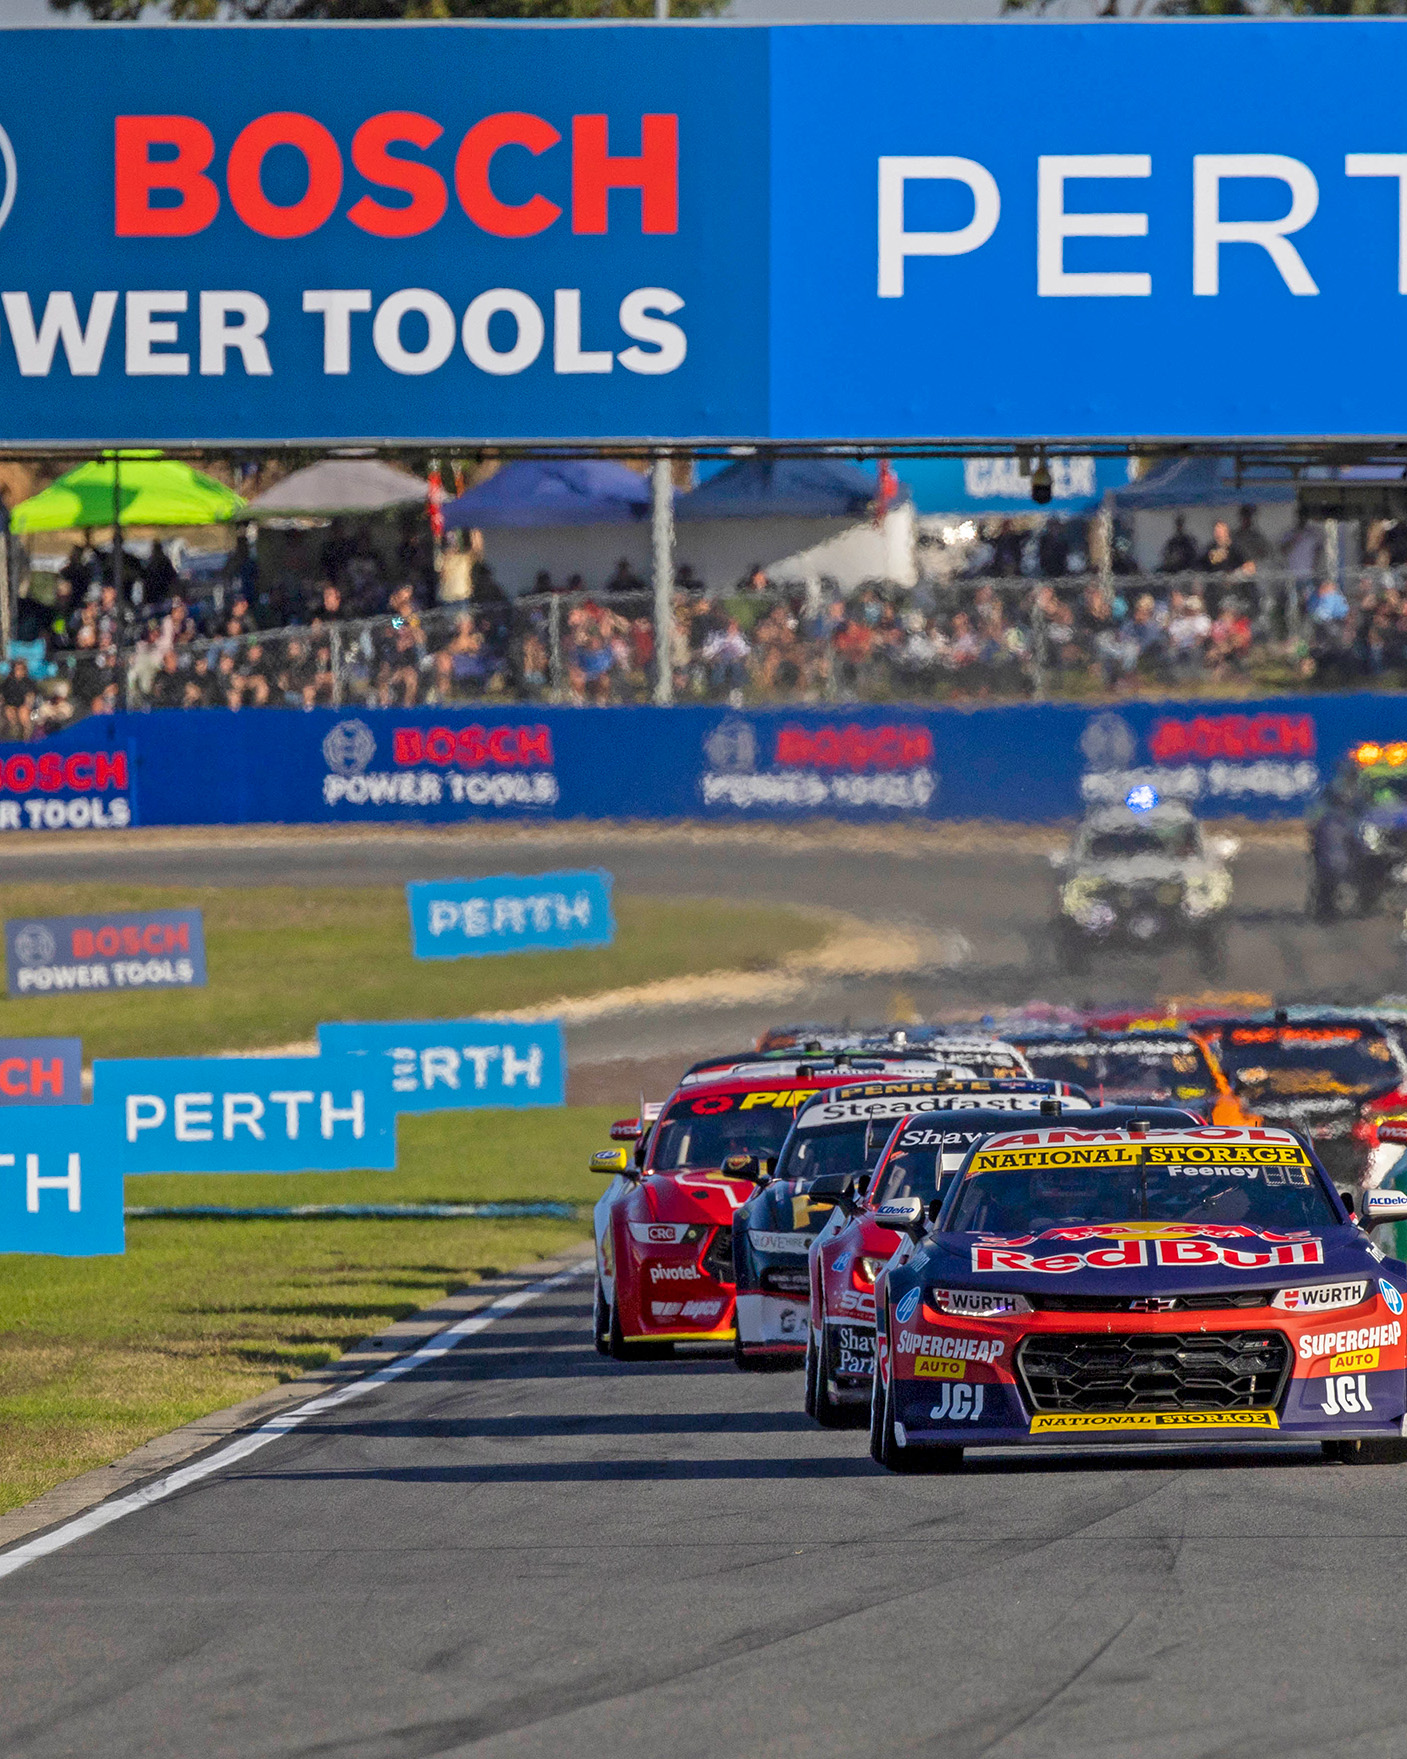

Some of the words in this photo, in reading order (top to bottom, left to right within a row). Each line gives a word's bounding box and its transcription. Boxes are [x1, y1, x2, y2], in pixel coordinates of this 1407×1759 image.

[115, 110, 680, 239] BOSCH
[0, 289, 273, 377] WER
[302, 287, 688, 376] TOOLS
[394, 725, 553, 768] BOSCH
[0, 751, 128, 793] OSCH
[323, 771, 442, 806] POWER
[23, 797, 131, 829] TOOLS
[428, 891, 590, 937] PERTH
[72, 922, 189, 959] BOSCH
[17, 964, 109, 991] POWER
[111, 959, 194, 986] TOOLS
[389, 1044, 543, 1092] ERTH
[125, 1090, 365, 1143] PERTH
[823, 1097, 1022, 1119] Steadfast
[985, 1128, 1291, 1149] AMPOL
[978, 1148, 1134, 1169] NATIONAL
[1150, 1147, 1298, 1163] STORAGE
[1168, 1166, 1259, 1179] Feeney
[649, 1227, 675, 1239] CRC
[972, 1240, 1148, 1273] Red
[1156, 1239, 1325, 1269] Bull
[1302, 1285, 1361, 1306] WÜRTH
[897, 1330, 1005, 1364] SUPERCHEAP
[1299, 1321, 1402, 1359] SUPERCHEAP
[919, 1360, 960, 1374] AUTO
[1335, 1353, 1374, 1368] AUTO
[930, 1383, 984, 1421] JGI
[1321, 1375, 1373, 1416] JGI
[1037, 1416, 1151, 1428] NATIONAL
[1162, 1413, 1267, 1424] STORAGE
